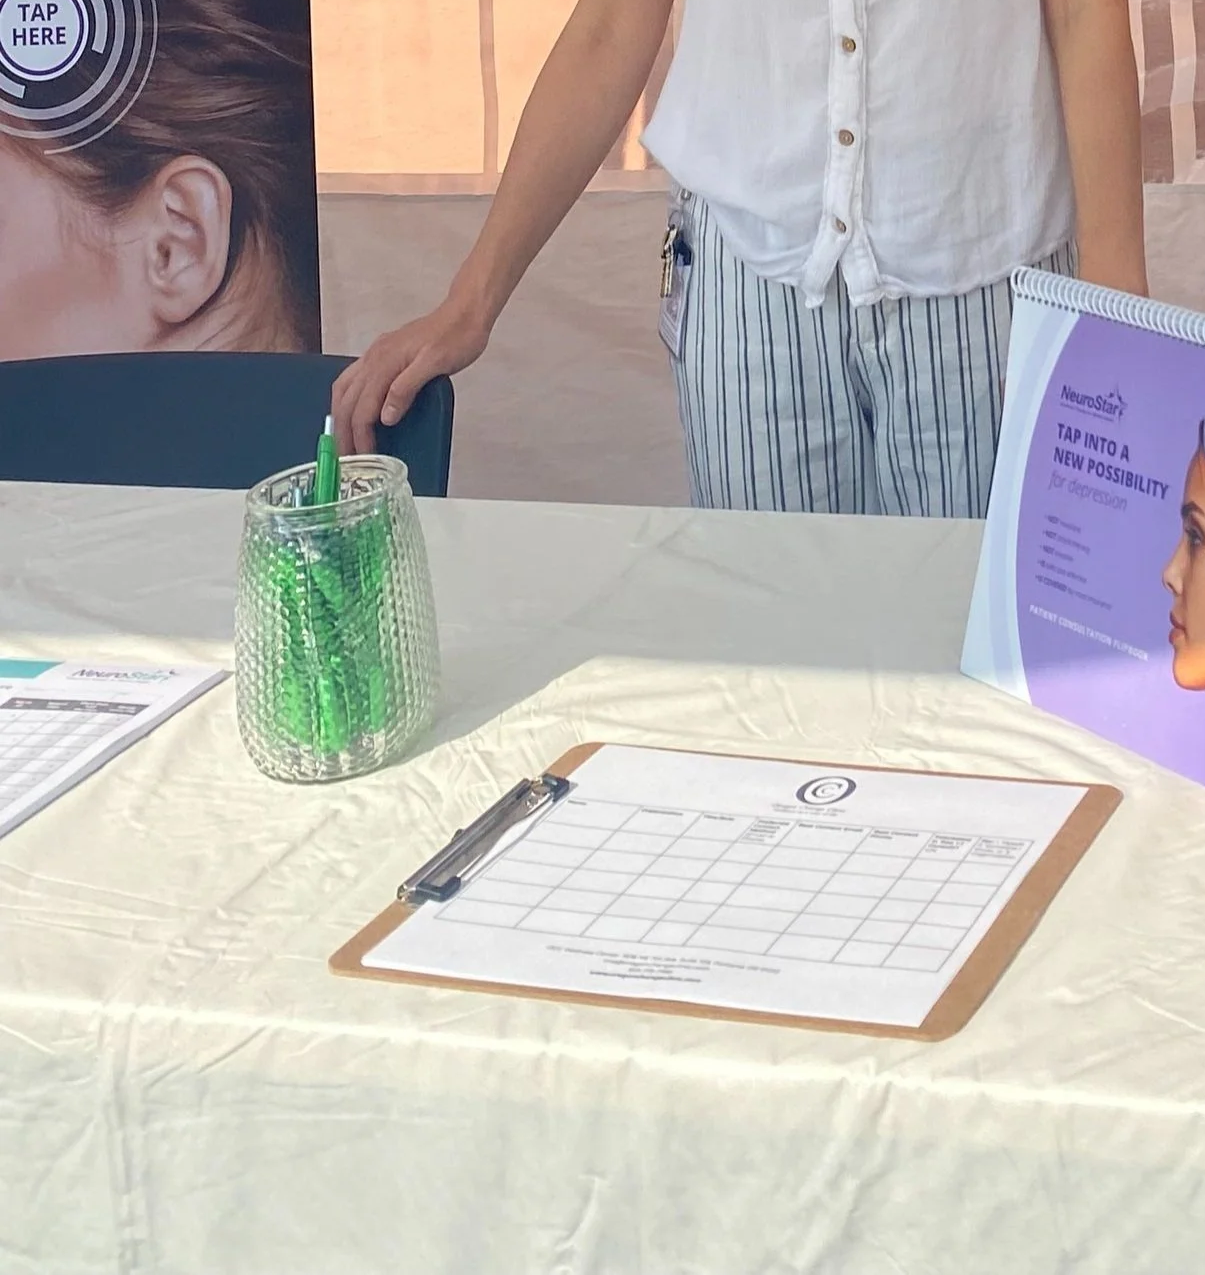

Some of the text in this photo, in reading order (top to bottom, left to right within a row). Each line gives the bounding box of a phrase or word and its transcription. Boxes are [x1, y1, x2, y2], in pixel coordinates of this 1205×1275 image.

[18, 3, 59, 23] TAP
[12, 26, 67, 46] HERE
[1061, 384, 1120, 416] NeuroStar
[1057, 423, 1130, 463] TAP INTO A
[1053, 446, 1169, 500] NEW POSSIBILITY
